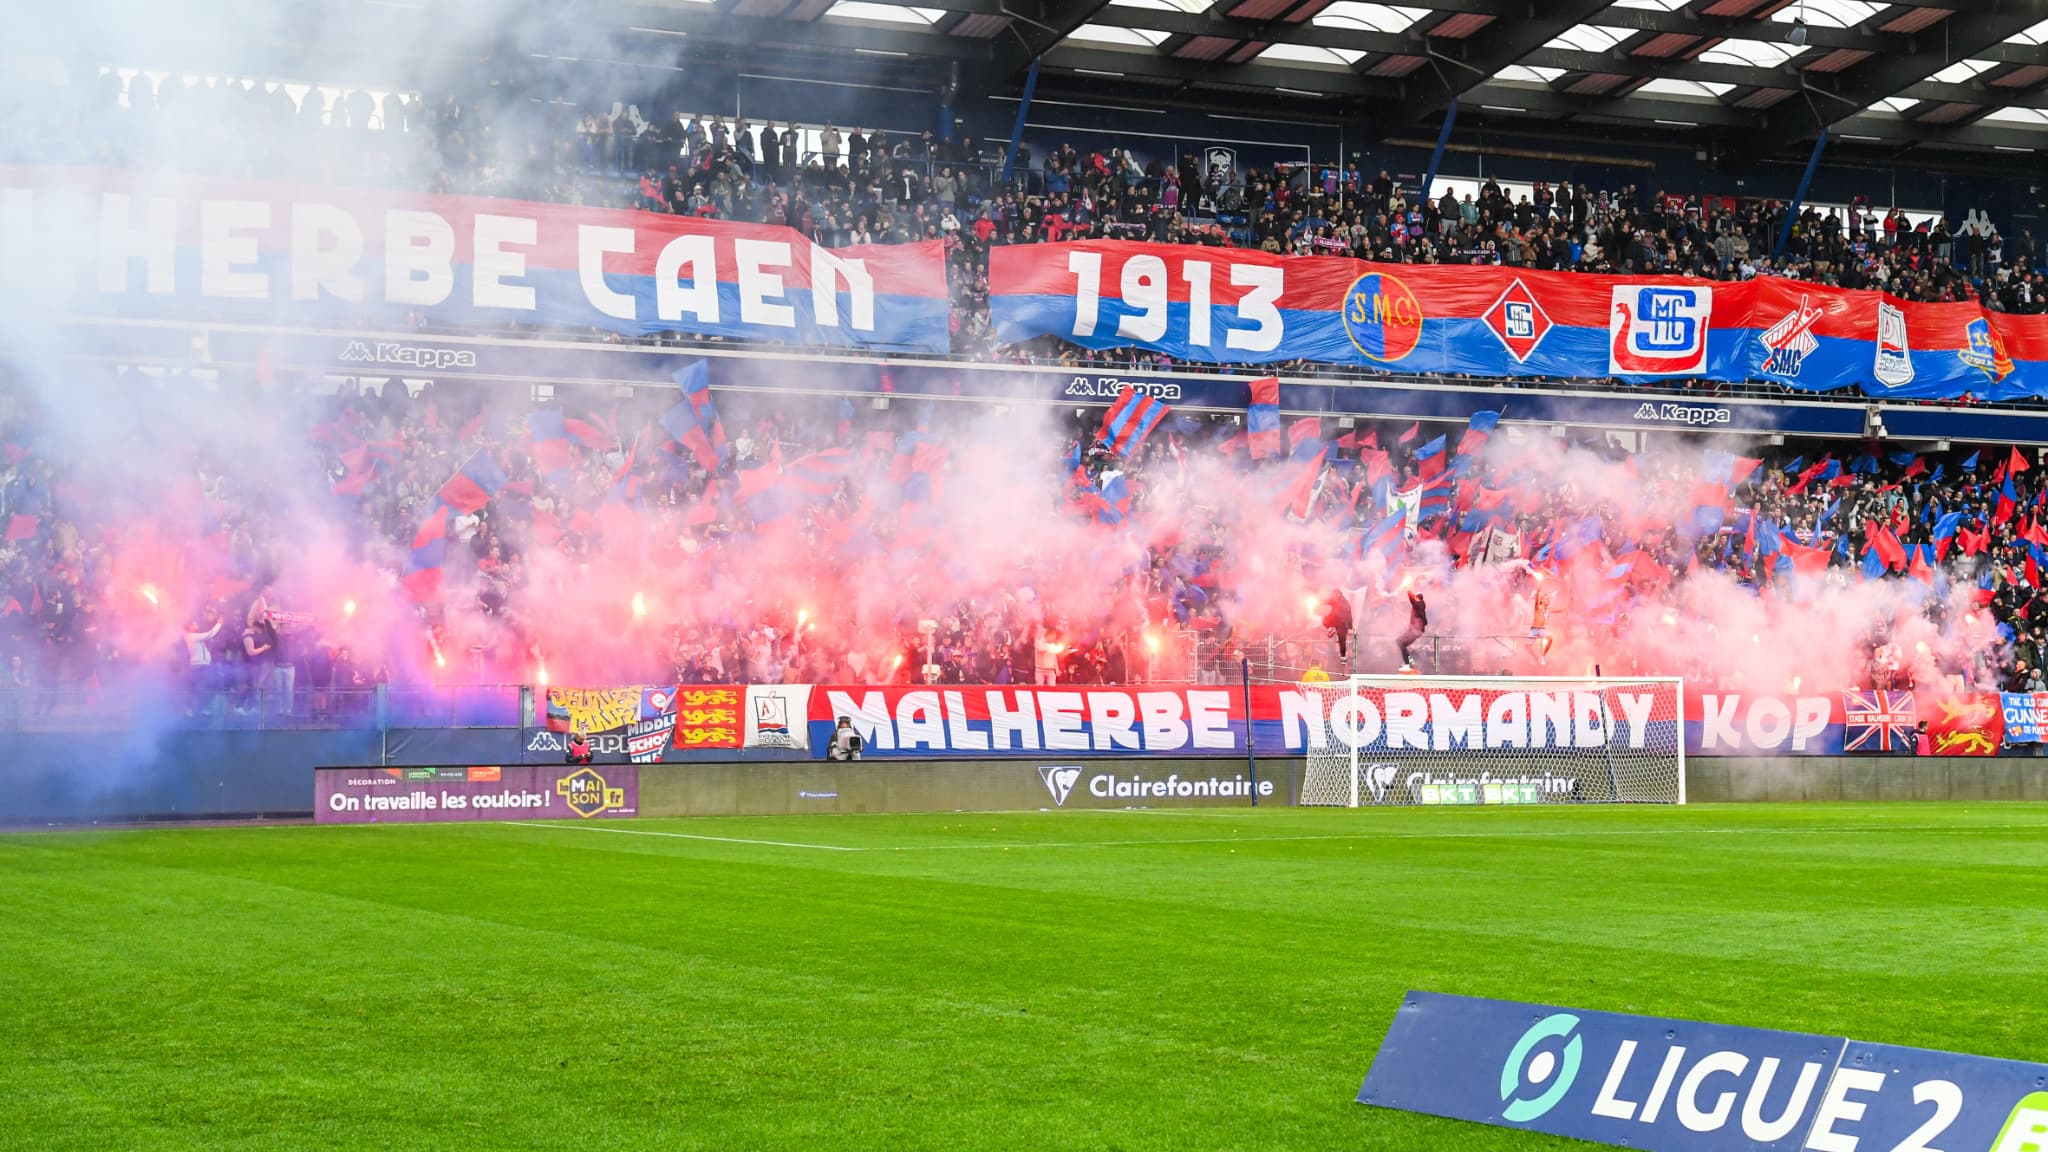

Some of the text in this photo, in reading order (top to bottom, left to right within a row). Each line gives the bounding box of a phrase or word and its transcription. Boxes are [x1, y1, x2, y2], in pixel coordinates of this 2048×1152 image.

[1069, 251, 1284, 353] 1913
[377, 343, 476, 368] Kappa
[1769, 346, 1802, 376] SMC
[1661, 403, 1731, 424] Kappa
[827, 690, 1832, 751] MALHERBE NORMANDY KOP
[629, 732, 669, 753] SCHO
[571, 778, 600, 793] MAI
[1088, 773, 1274, 798] Clairefontaine
[1423, 787, 1475, 801] BKT
[1485, 787, 1536, 801] BKT
[329, 792, 360, 811] On
[364, 791, 437, 811] travaille
[441, 790, 467, 809] les
[572, 792, 600, 804] SON
[1591, 1039, 1887, 1152] LIGUE
[1893, 1078, 1964, 1152] 2
